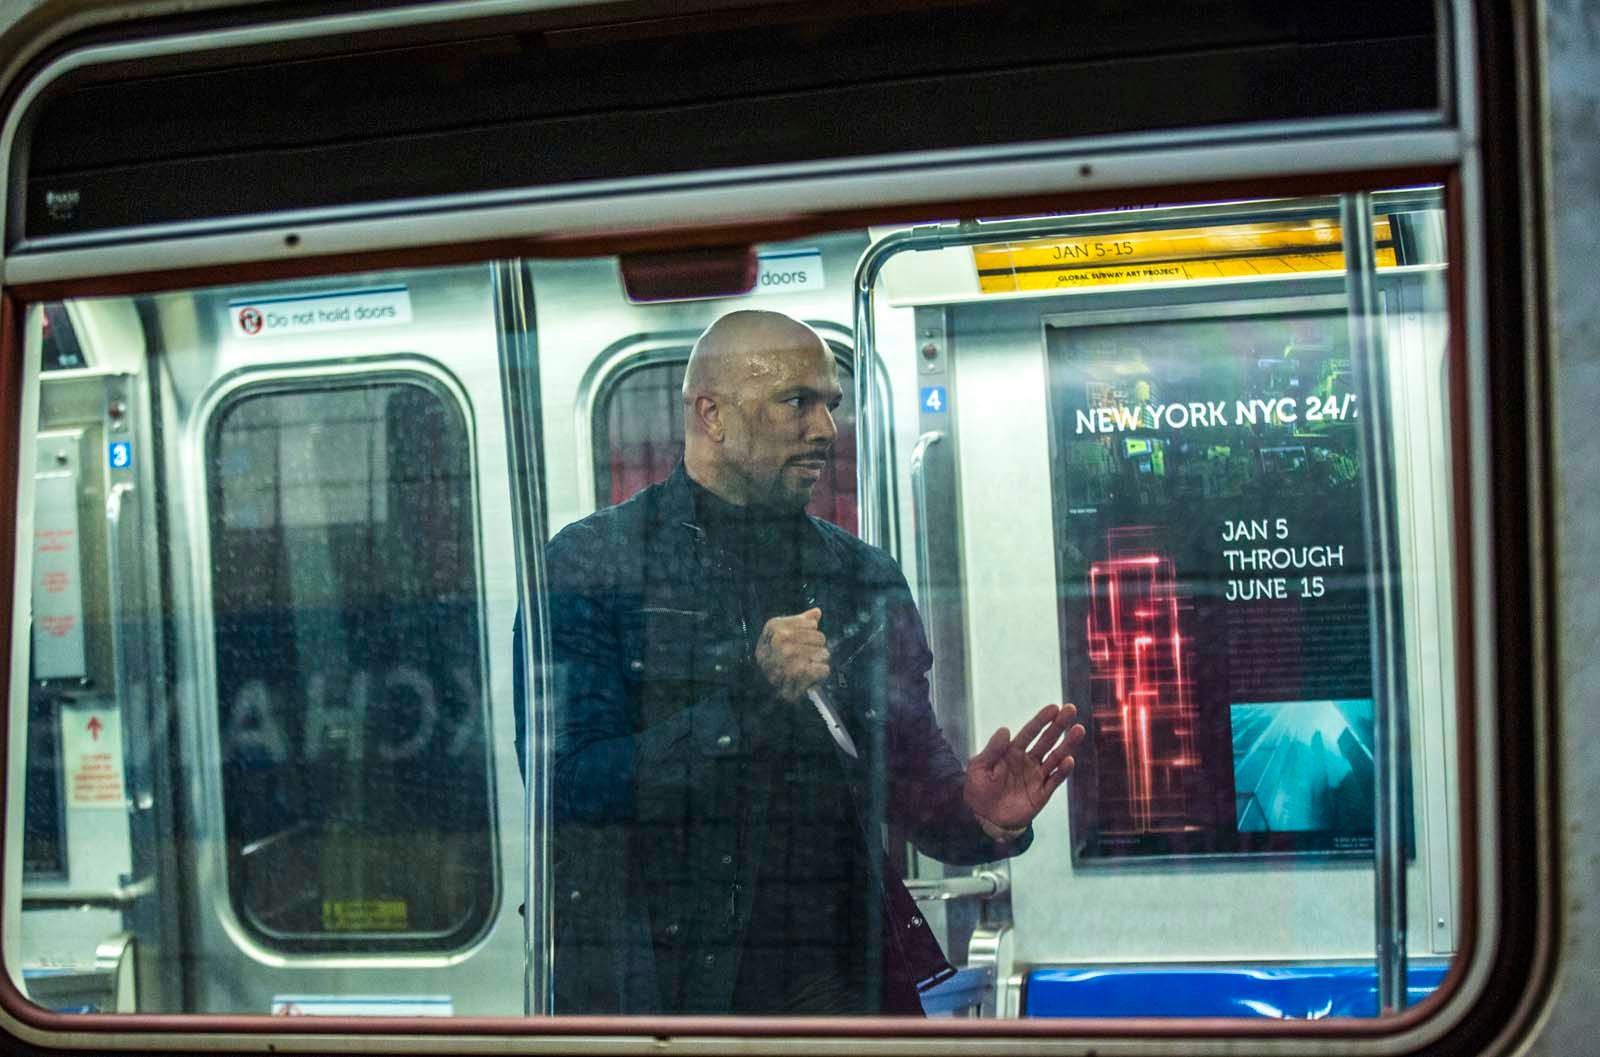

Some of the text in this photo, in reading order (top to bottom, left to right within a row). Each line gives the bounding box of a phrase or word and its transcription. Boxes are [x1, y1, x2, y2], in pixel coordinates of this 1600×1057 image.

[1052, 241, 1134, 260] JAN 5-15
[761, 269, 807, 286] doors
[1057, 267, 1179, 282] GLOBAL SUBWAY ART PROJECT
[267, 304, 396, 329] Do not hold doors
[926, 389, 942, 411] 4
[1075, 405, 1140, 434] NEW
[1145, 400, 1227, 430] YORK
[1235, 397, 1298, 425] NYC
[113, 444, 128, 466] 3
[1222, 518, 1289, 542] JAN 5
[1223, 545, 1345, 572] THROUGH
[1225, 576, 1326, 602] JUNE 15
